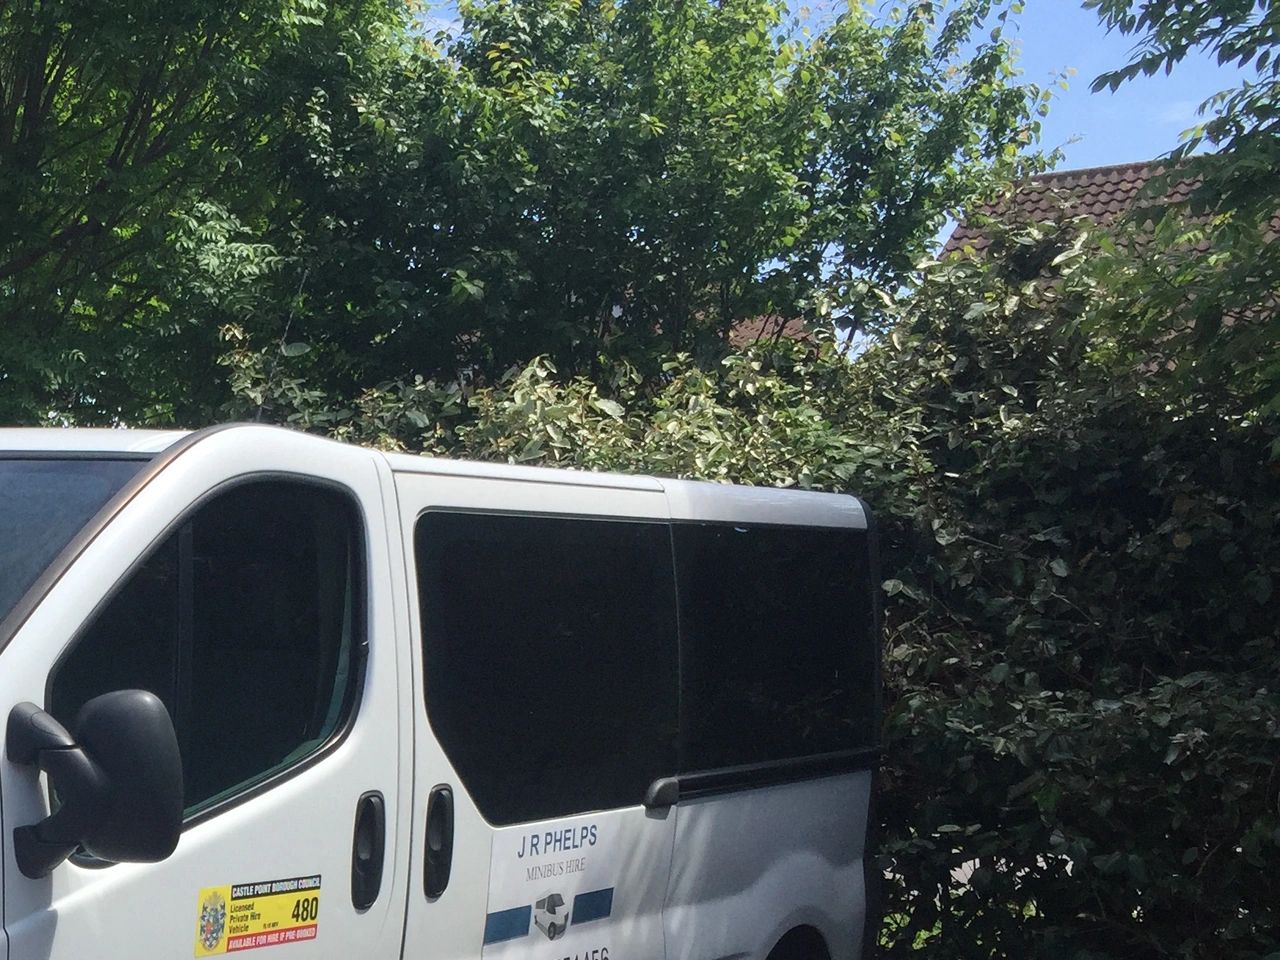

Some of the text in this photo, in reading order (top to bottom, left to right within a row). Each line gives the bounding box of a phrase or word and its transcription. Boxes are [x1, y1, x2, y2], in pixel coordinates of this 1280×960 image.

[517, 824, 597, 858] J R PHELPS
[526, 857, 586, 882] MINIBUS HIRE
[232, 886, 253, 897] CASTLE
[254, 883, 271, 894] POINT
[272, 880, 297, 892] BOROUGH
[230, 902, 254, 912] Licensed
[292, 896, 318, 922] 480
[230, 911, 261, 924] Private Hire
[229, 924, 249, 934] Vehicle
[228, 936, 256, 950] AVAILABLE
[256, 935, 266, 945] FOR
[266, 933, 279, 943] HIRE
